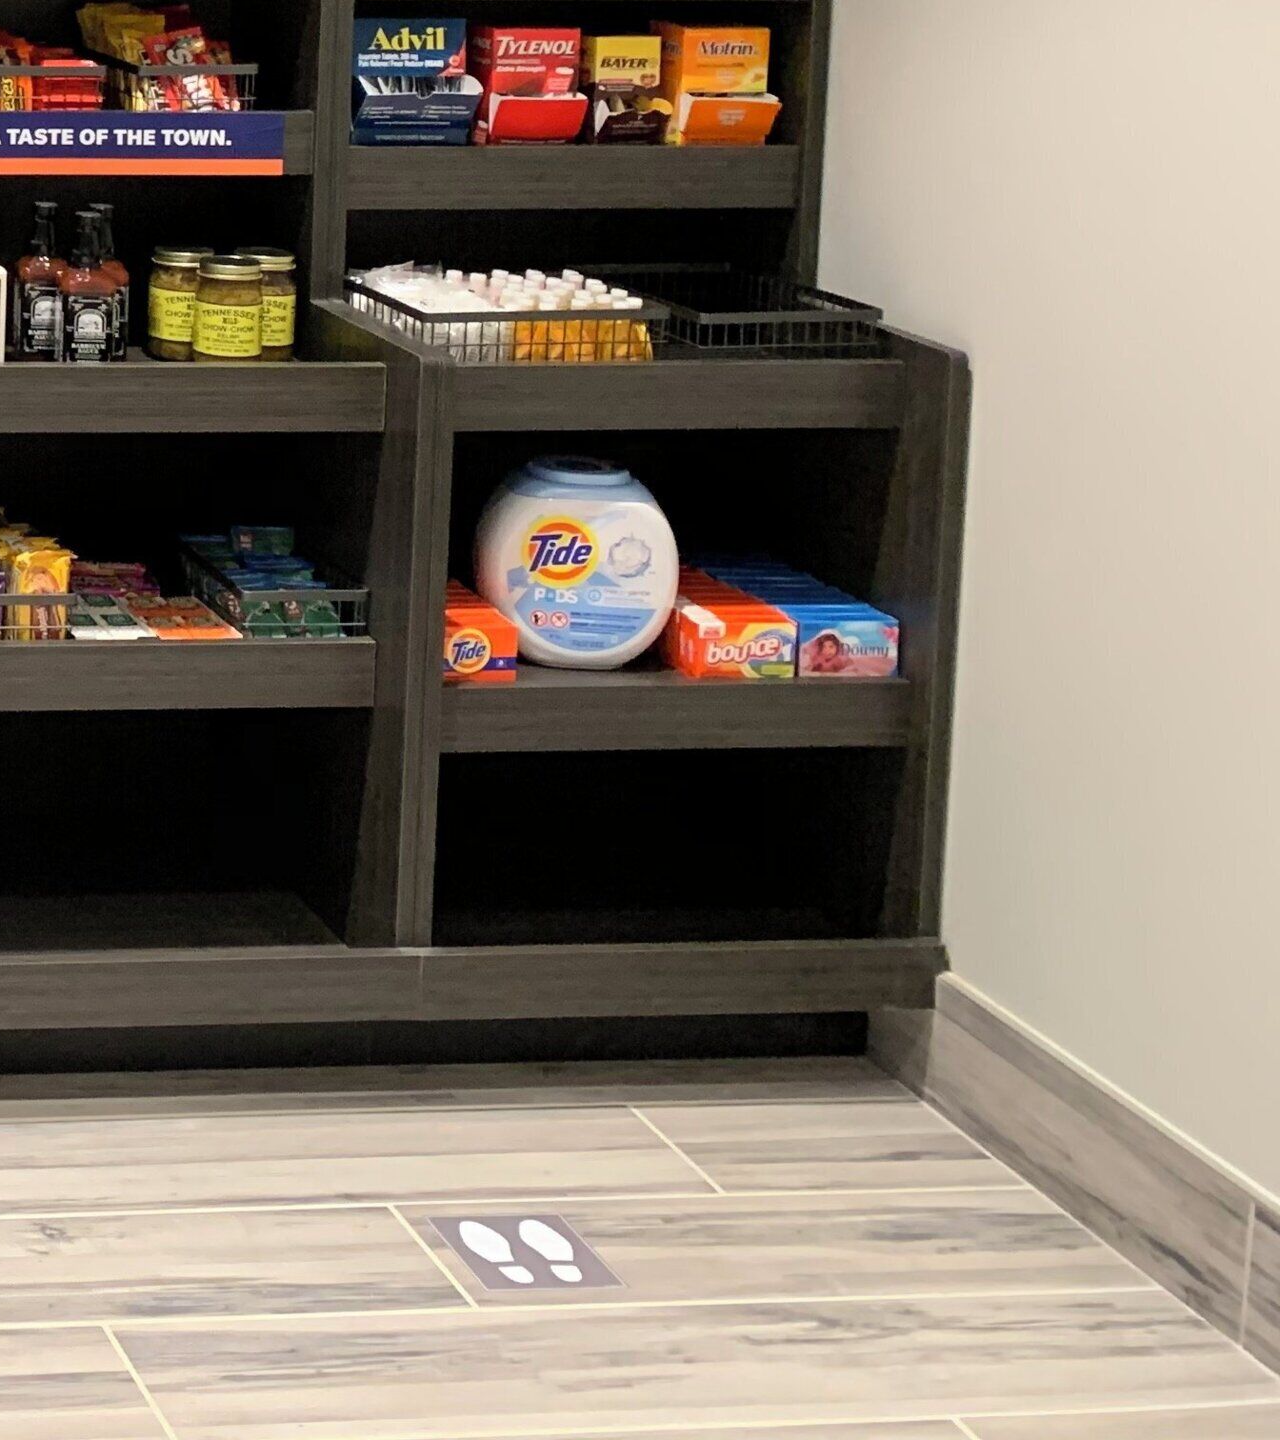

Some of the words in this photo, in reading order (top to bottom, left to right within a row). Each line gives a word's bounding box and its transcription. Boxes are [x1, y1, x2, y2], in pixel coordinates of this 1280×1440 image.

[368, 27, 446, 51] Advil
[496, 36, 576, 57] TYLENOL
[701, 41, 754, 56] Motrin
[600, 58, 649, 69] BAYER
[6, 128, 74, 146] TASTE
[79, 128, 109, 146] OF
[113, 128, 156, 146] THE
[161, 128, 232, 146] TOWN.
[164, 296, 196, 304] TENNE
[201, 309, 256, 321] TENNESSEE
[529, 534, 593, 572] Tide
[452, 640, 486, 667] Tide
[708, 637, 780, 664] bounce
[841, 643, 890, 659] Downy
